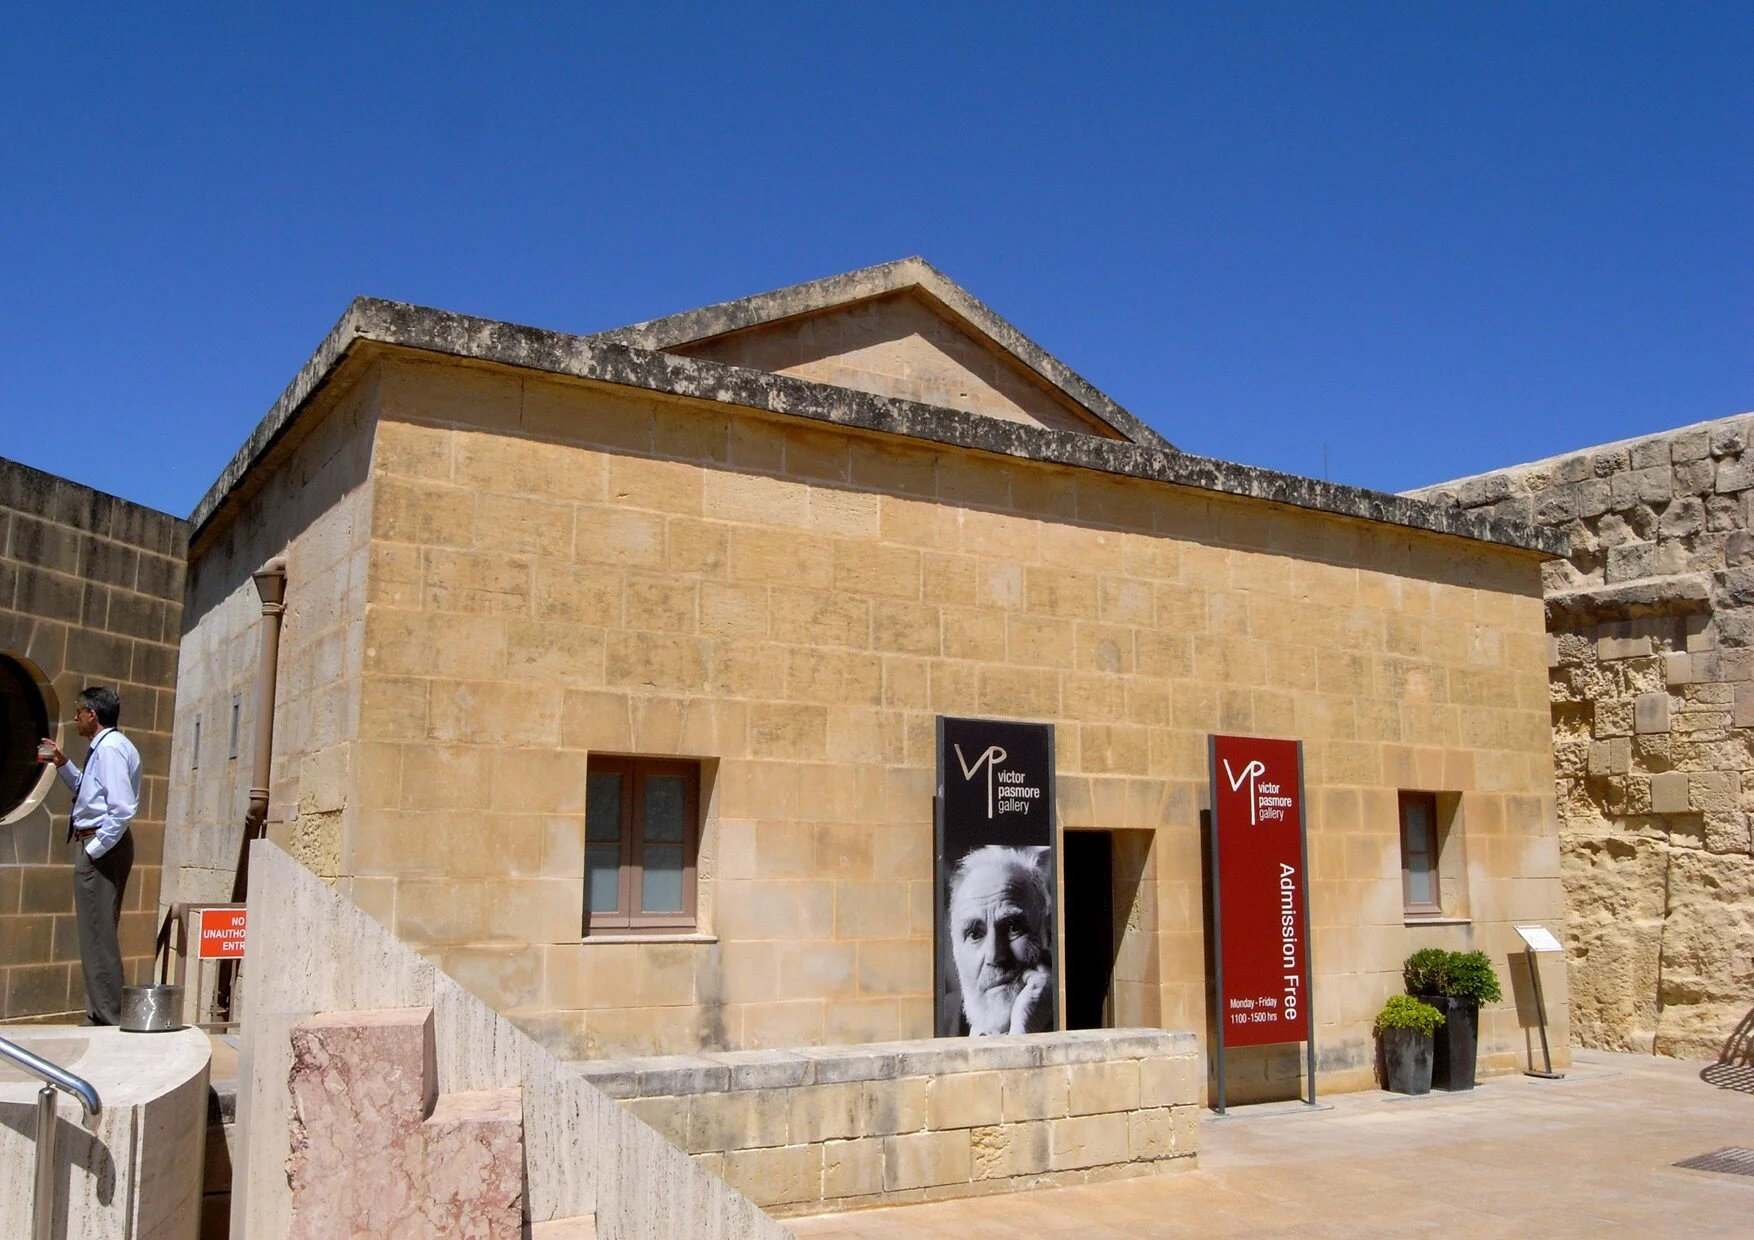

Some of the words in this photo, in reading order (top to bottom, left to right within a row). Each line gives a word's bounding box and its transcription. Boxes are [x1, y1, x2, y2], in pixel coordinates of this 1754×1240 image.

[998, 770, 1025, 783] victor
[998, 786, 1040, 799] pasmore
[1258, 782, 1280, 794] victor
[998, 799, 1029, 814] gallery
[1259, 796, 1292, 808] pasmore
[1259, 807, 1284, 821] gallery
[232, 917, 245, 926] NO
[1280, 863, 1297, 968] Admission
[1230, 998, 1254, 1009] Monday
[1258, 996, 1277, 1008] Friday
[1284, 975, 1299, 1020] Free
[1230, 1013, 1247, 1024] 1100
[1267, 1011, 1277, 1021] hrs
